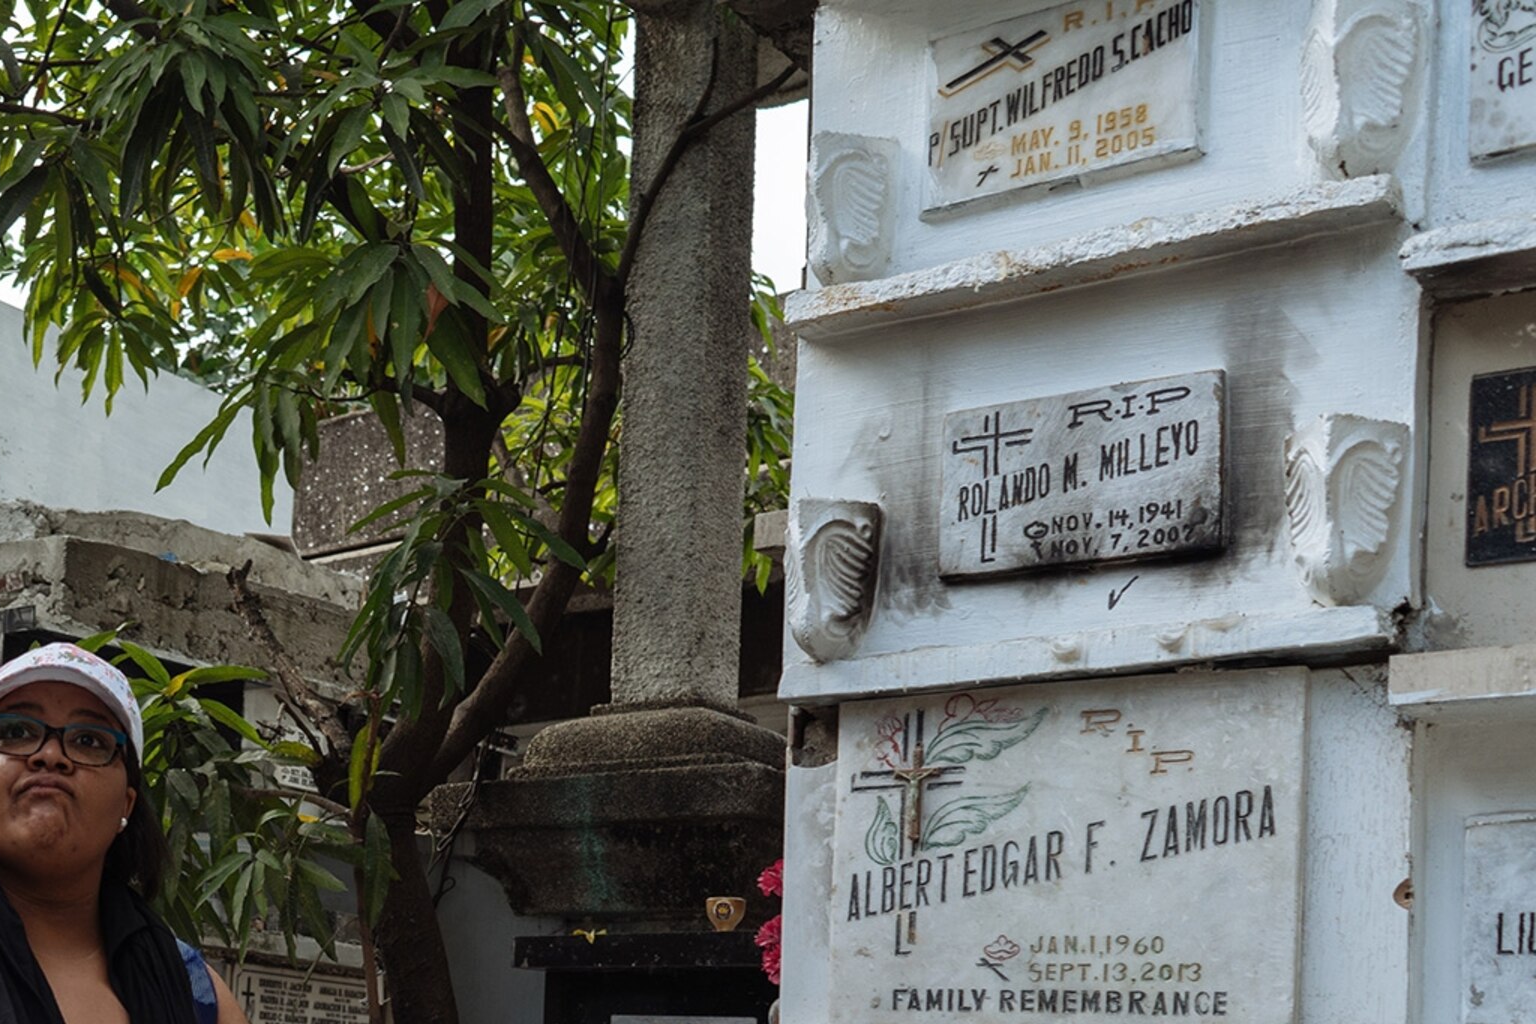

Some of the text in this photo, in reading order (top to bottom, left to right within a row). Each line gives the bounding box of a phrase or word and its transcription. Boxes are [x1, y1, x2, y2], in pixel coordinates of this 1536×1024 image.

[1097, 103, 1148, 135] 1958
[1096, 126, 1155, 158] 2005
[957, 420, 1199, 522] ROLANDO M. MILLEYO
[1052, 512, 1102, 535] NOV.
[1084, 819, 1116, 874] F.
[1139, 784, 1277, 863] ZAMORA
[891, 988, 1228, 1017] FAMILY REMEMBRANCE
